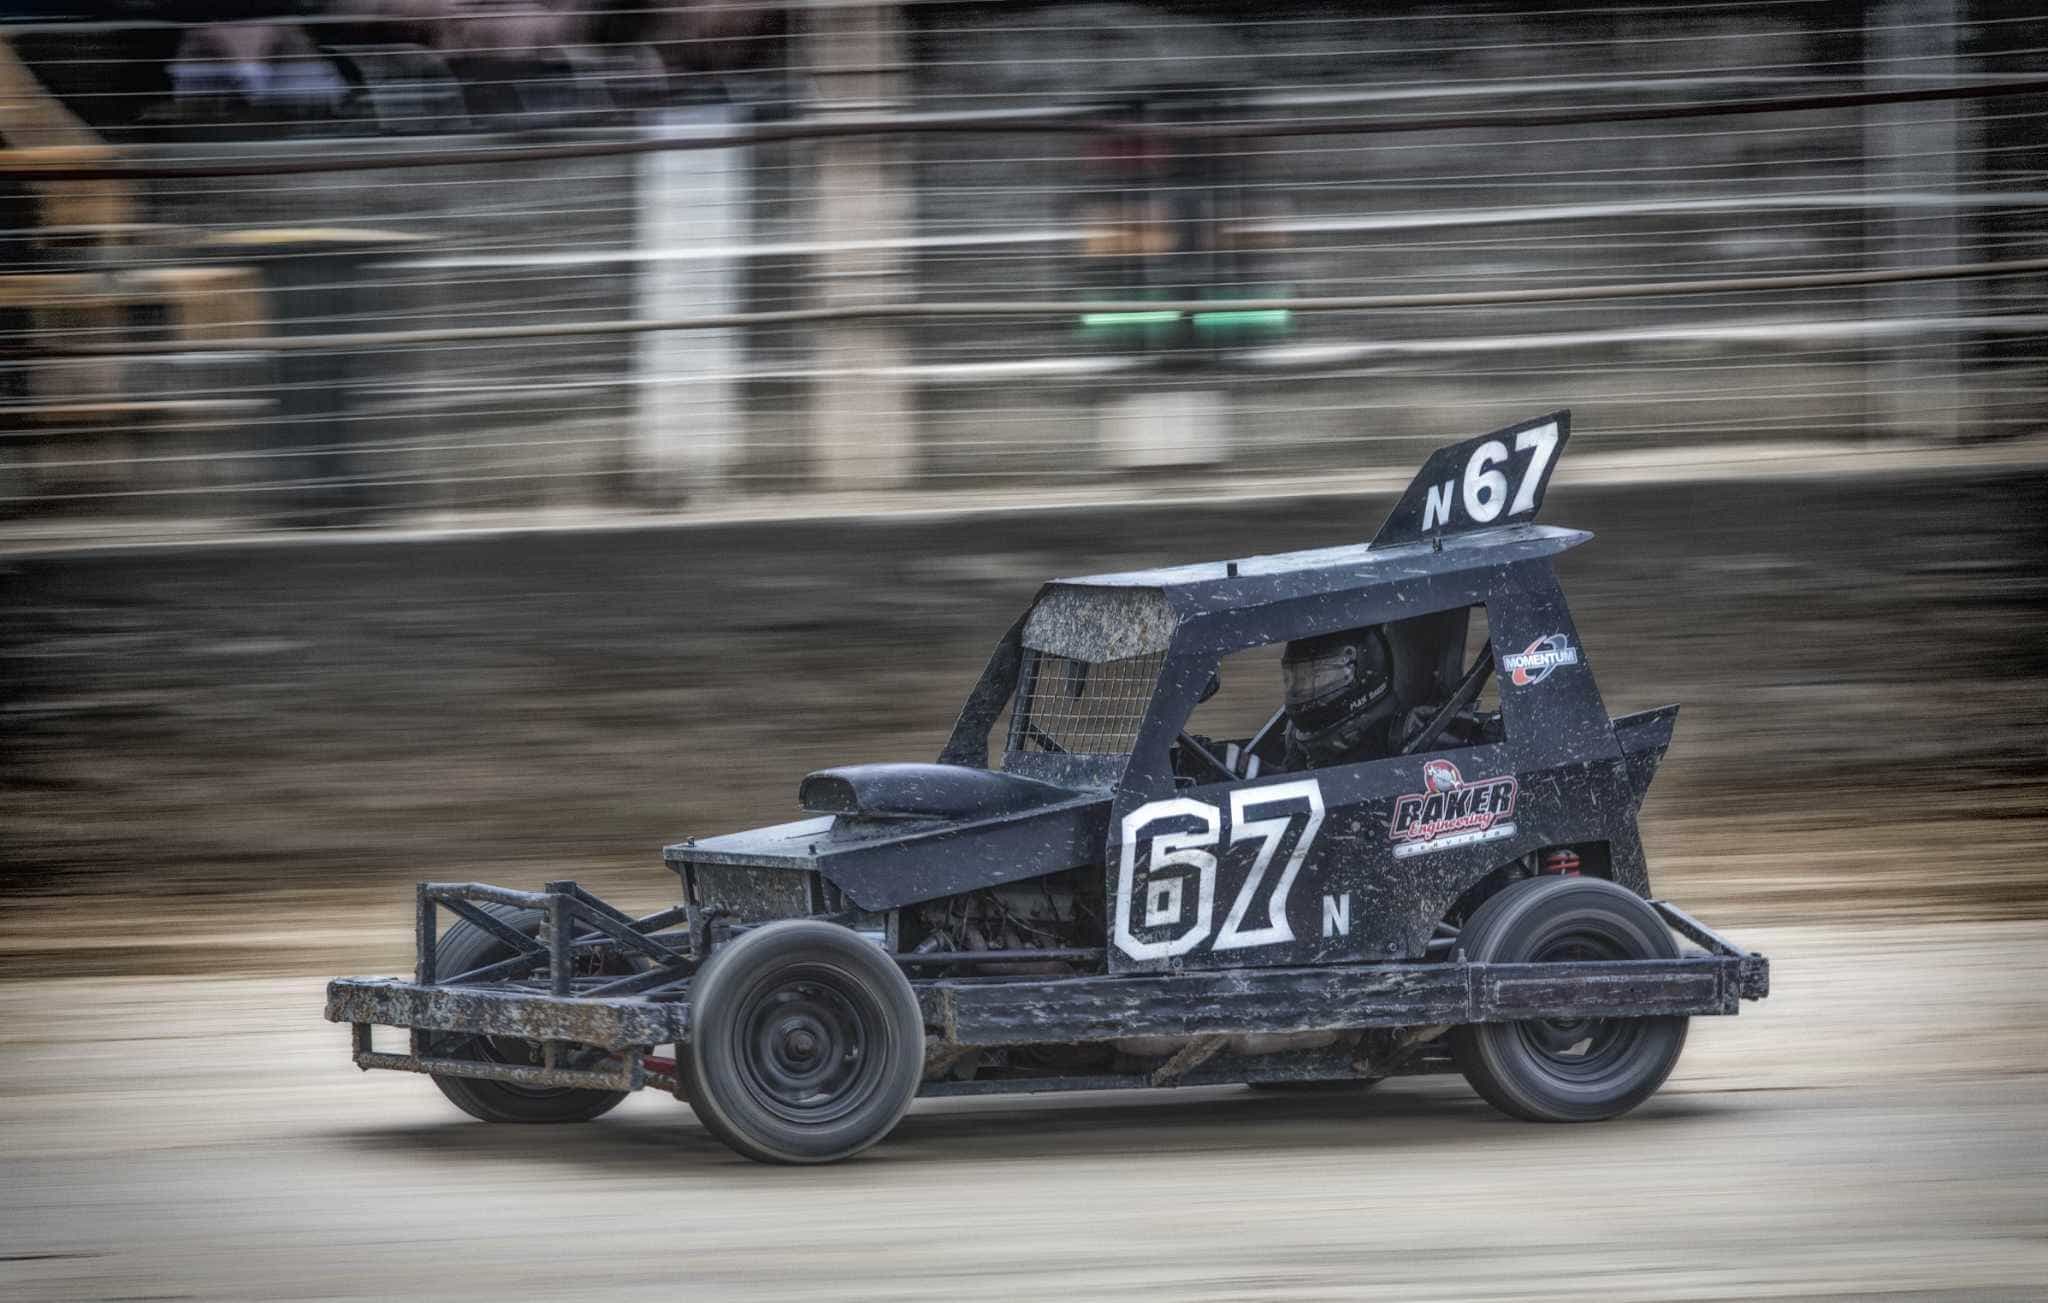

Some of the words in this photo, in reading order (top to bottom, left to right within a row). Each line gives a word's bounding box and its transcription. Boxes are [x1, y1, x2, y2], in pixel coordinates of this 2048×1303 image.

[1421, 480, 1455, 532] N
[1463, 421, 1559, 523] 67
[1504, 648, 1576, 670] MOMENTUM
[1394, 780, 1514, 834] BAKER
[1408, 811, 1494, 839] Engineering
[1114, 778, 1326, 961] 67
[1322, 893, 1350, 937] N
